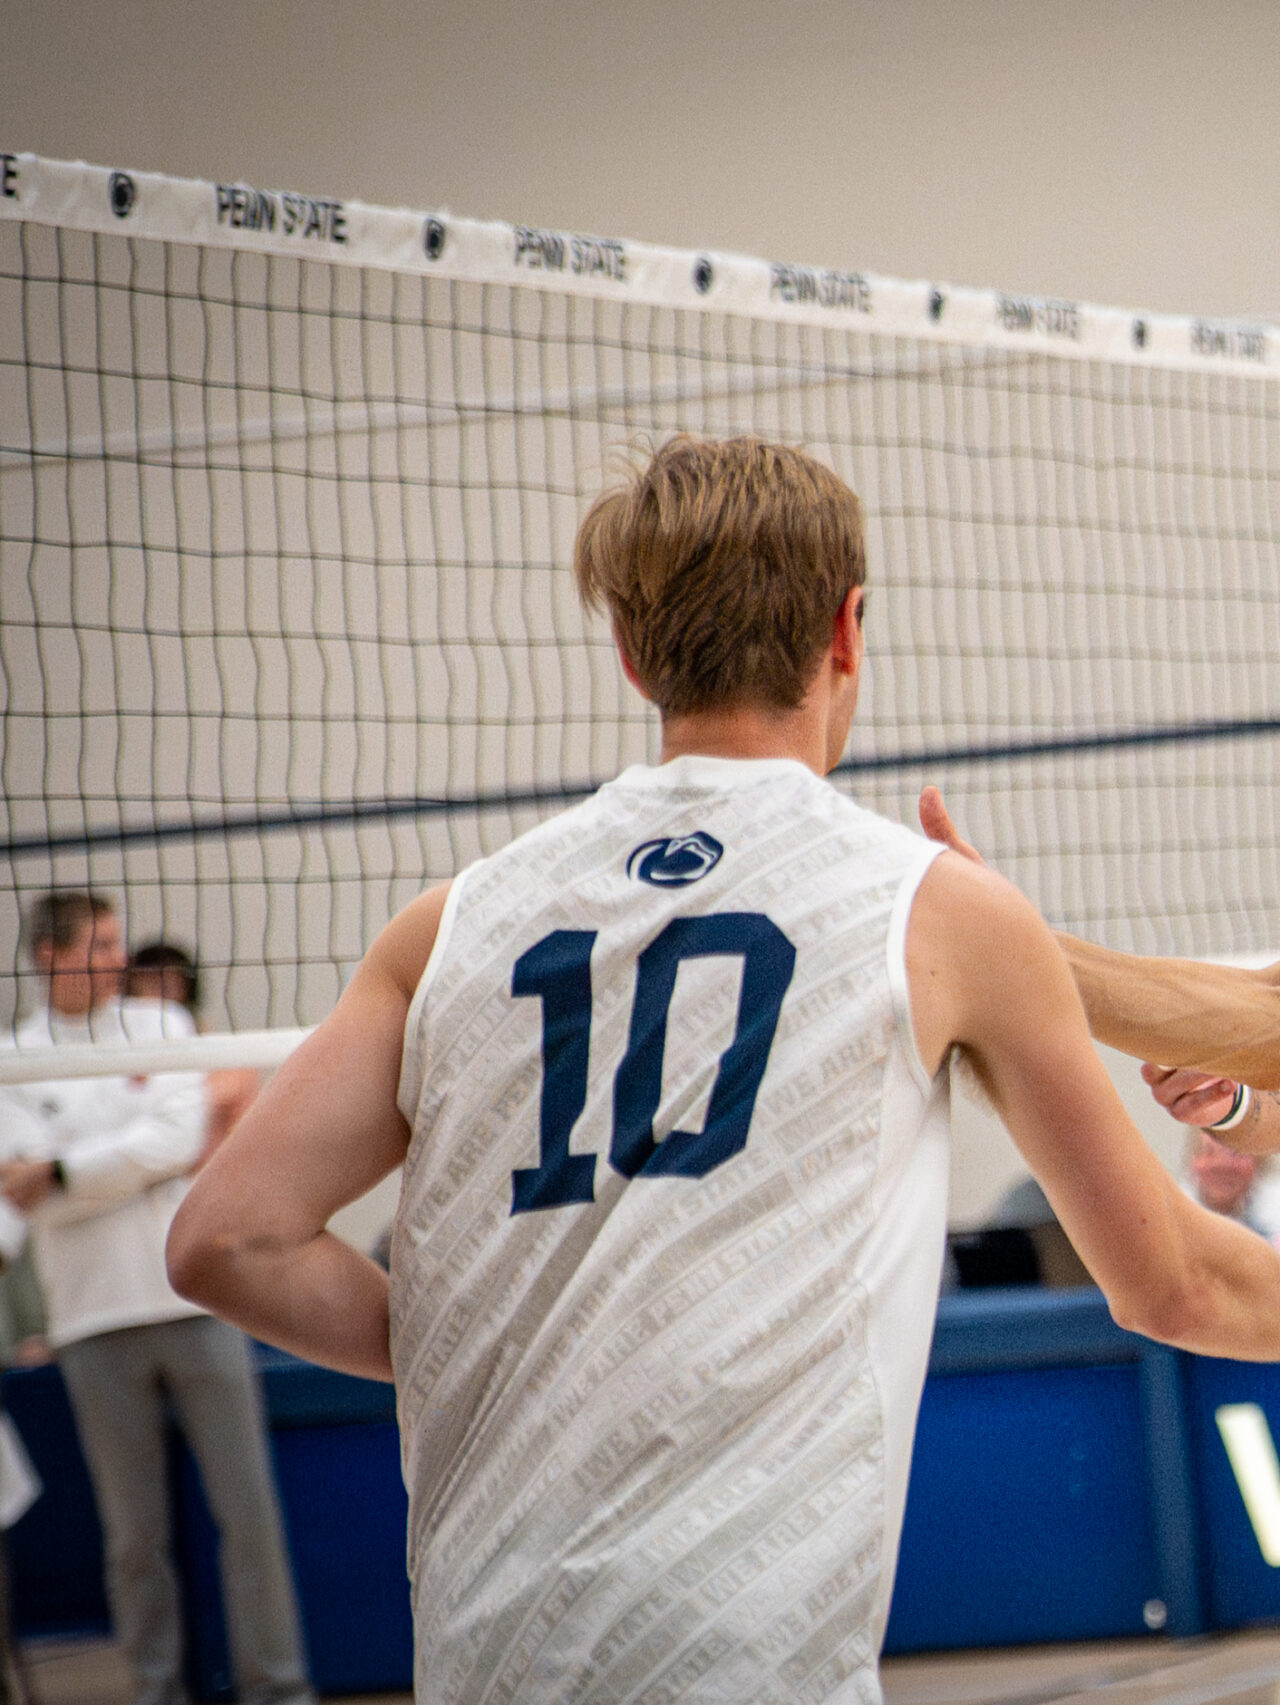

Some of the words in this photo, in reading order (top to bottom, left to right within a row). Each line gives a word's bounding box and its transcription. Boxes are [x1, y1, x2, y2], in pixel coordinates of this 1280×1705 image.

[215, 183, 276, 233] PENN
[282, 193, 348, 244] STATE
[570, 235, 627, 283] STATE
[510, 912, 796, 1217] 10
